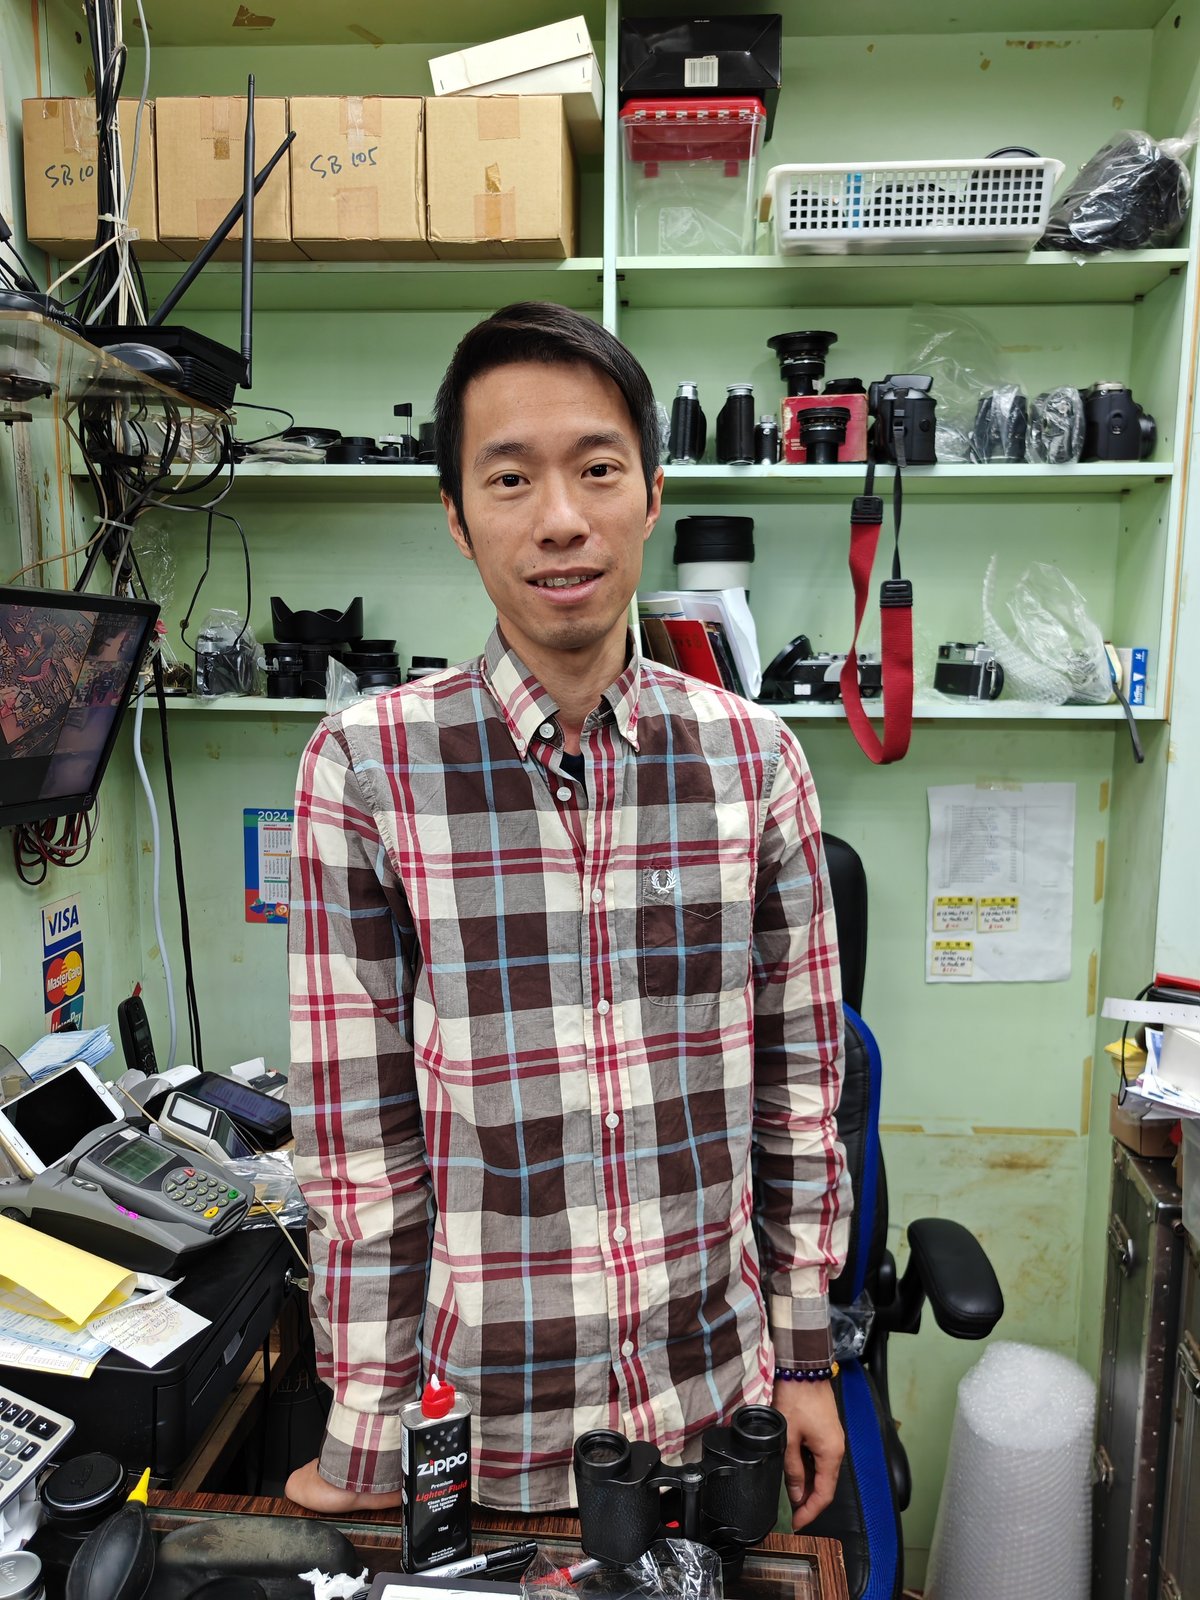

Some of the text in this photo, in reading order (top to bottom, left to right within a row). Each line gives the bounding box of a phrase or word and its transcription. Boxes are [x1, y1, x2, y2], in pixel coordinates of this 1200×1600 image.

[80, 165, 95, 182] 10
[310, 146, 378, 179] SB 105
[257, 811, 288, 822] 2024
[47, 904, 79, 937] VISA
[416, 1452, 468, 1477] zippo
[416, 1479, 468, 1502] Lighter Fluid
[430, 1479, 454, 1490] Premium
